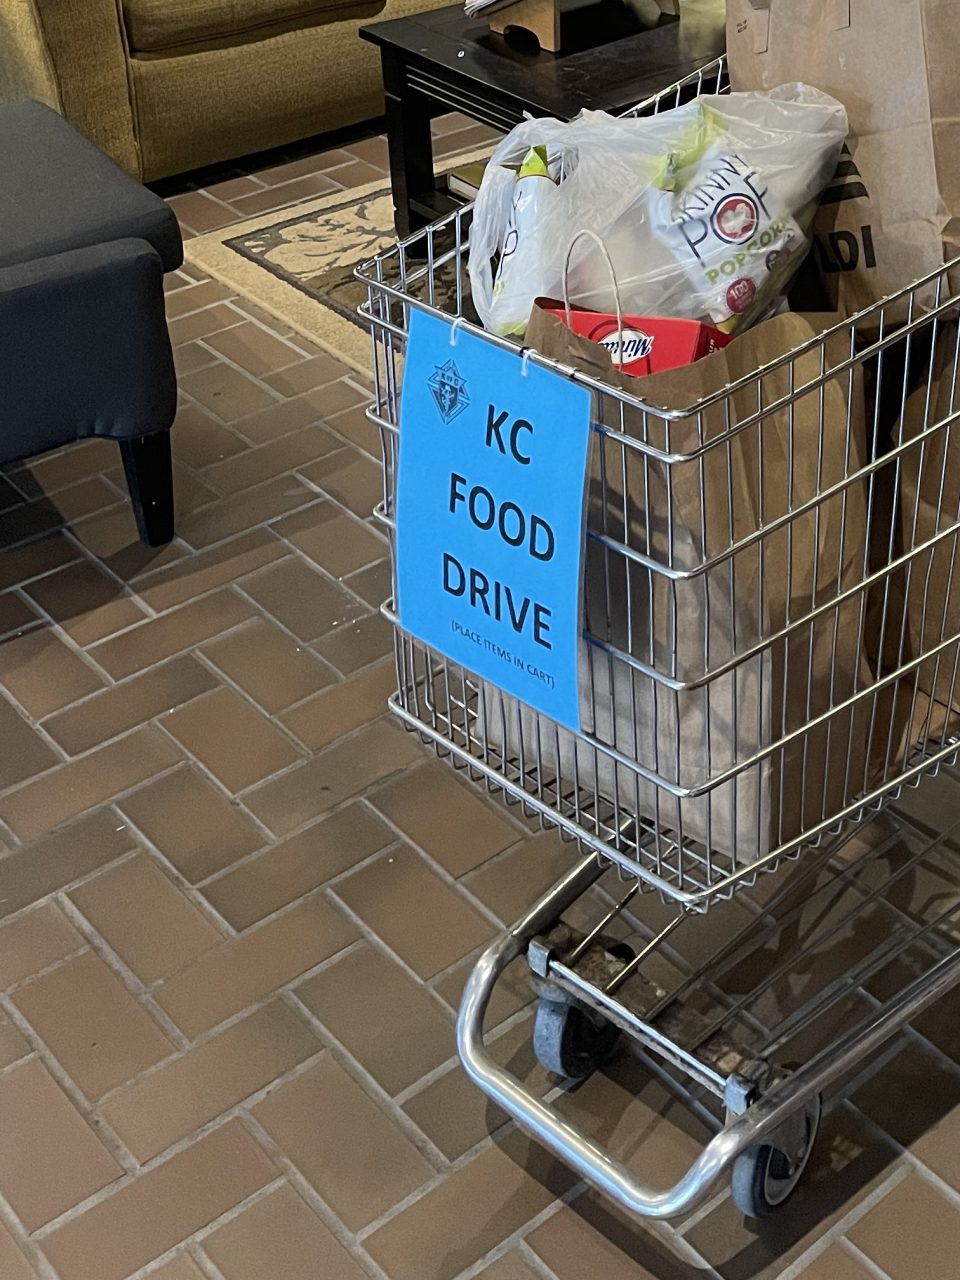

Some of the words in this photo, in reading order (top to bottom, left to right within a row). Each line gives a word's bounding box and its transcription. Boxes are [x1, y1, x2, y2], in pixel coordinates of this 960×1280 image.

[813, 225, 877, 274] LDI
[730, 279, 749, 300] 100
[486, 403, 533, 465] KC
[449, 472, 556, 562] FOOD
[443, 552, 552, 650] DRIVE
[452, 619, 482, 646] (PLACE
[484, 638, 512, 663] ITEMS
[513, 656, 525, 670] IN
[527, 663, 556, 689] CART)
